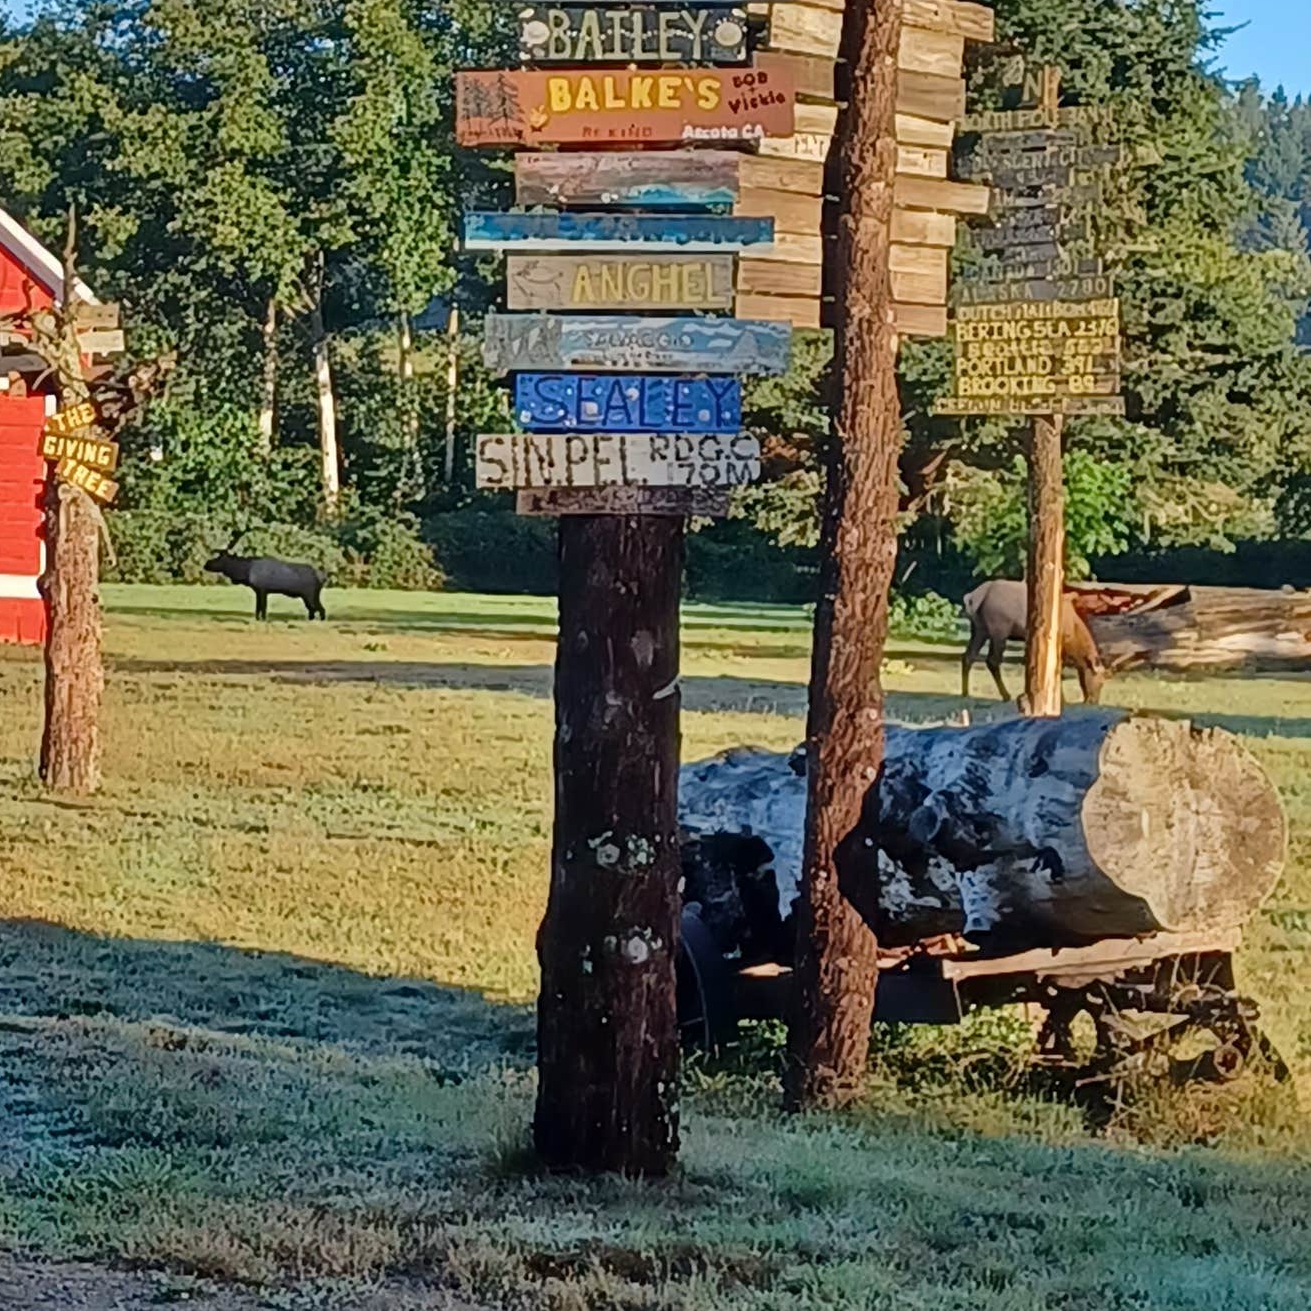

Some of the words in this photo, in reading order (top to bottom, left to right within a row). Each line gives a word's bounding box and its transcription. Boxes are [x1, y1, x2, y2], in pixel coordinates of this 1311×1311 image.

[548, 9, 709, 61] BAILEY
[548, 76, 721, 113] BALKE'S
[572, 262, 728, 304] ANGHEL
[956, 321, 1031, 342] BERING
[1033, 320, 1071, 339] SEA
[956, 356, 1052, 377] PORTLAND
[52, 402, 96, 432] THE
[532, 375, 737, 427] SEALEY
[43, 434, 112, 466] GIVING
[62, 458, 111, 498] TREE
